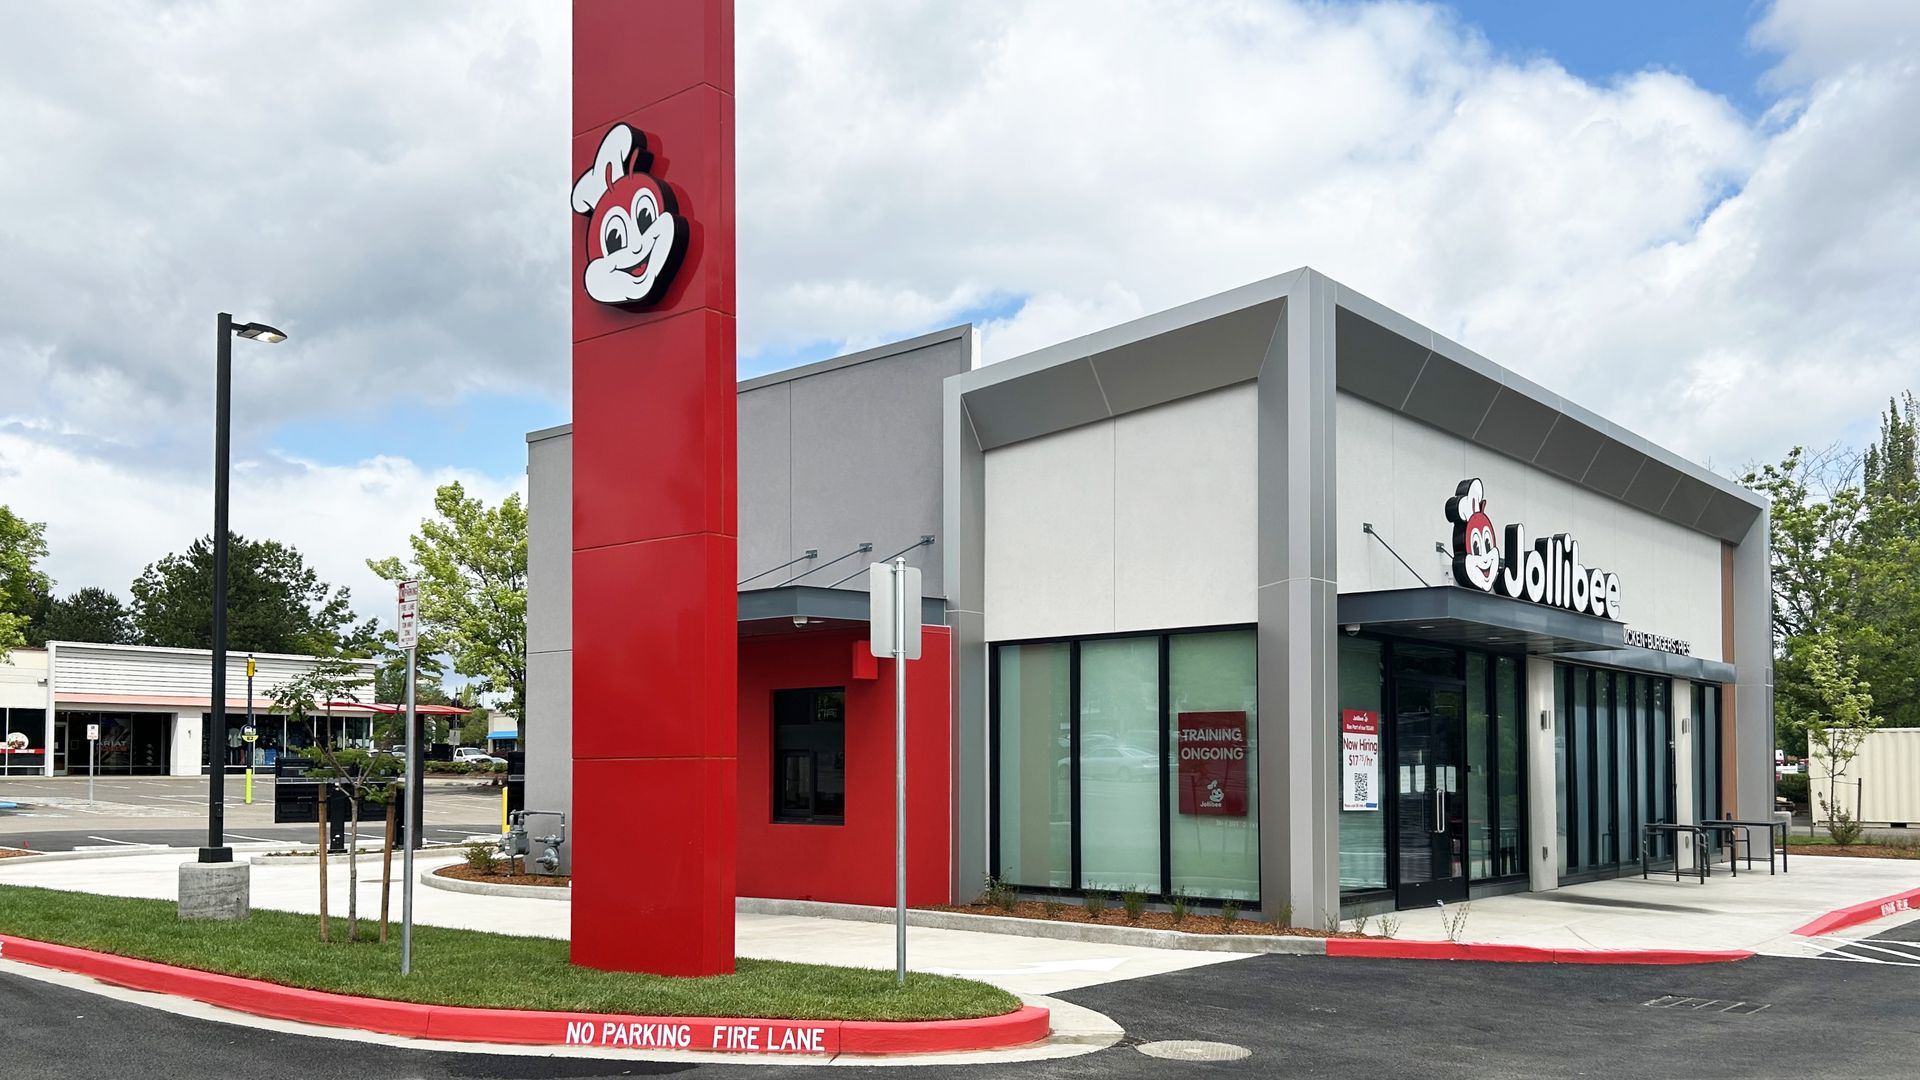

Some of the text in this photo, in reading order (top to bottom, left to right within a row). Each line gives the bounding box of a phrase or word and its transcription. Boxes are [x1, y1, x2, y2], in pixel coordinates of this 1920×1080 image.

[1504, 523, 1621, 620] Jollibee
[1647, 633, 1677, 654] BURGERS
[1678, 640, 1691, 656] PIES
[1182, 728, 1242, 742] TRAINING
[1181, 747, 1244, 760] ONGOING
[1343, 738, 1378, 755] Now Hiring
[566, 1021, 825, 1051] NO PARKING FIRE LANE
